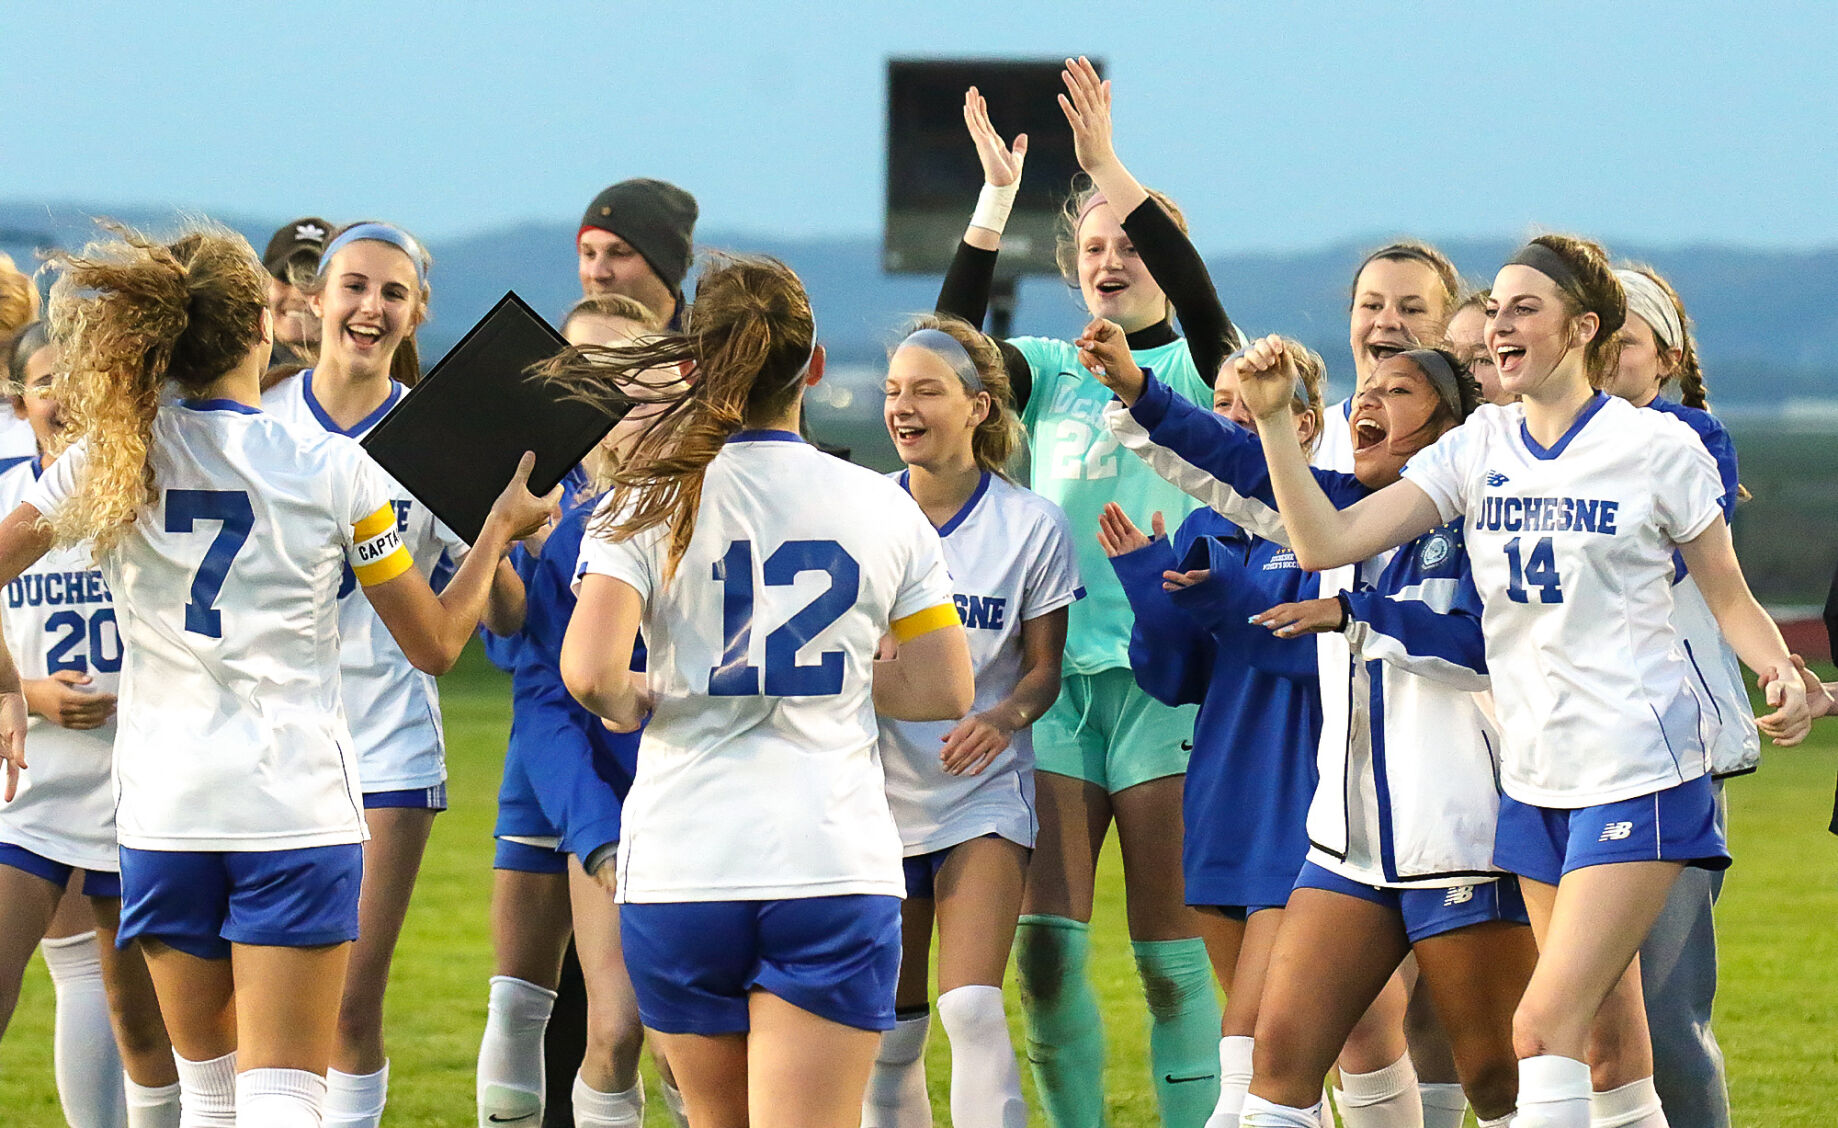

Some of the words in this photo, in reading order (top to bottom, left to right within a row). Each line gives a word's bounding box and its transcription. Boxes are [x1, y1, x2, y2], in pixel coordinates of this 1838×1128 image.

[1050, 419, 1120, 481] 22
[164, 489, 255, 639] 7
[358, 527, 400, 561] CAPTA
[1503, 536, 1564, 604] 14
[45, 609, 124, 676] 20
[708, 540, 860, 697] 12
